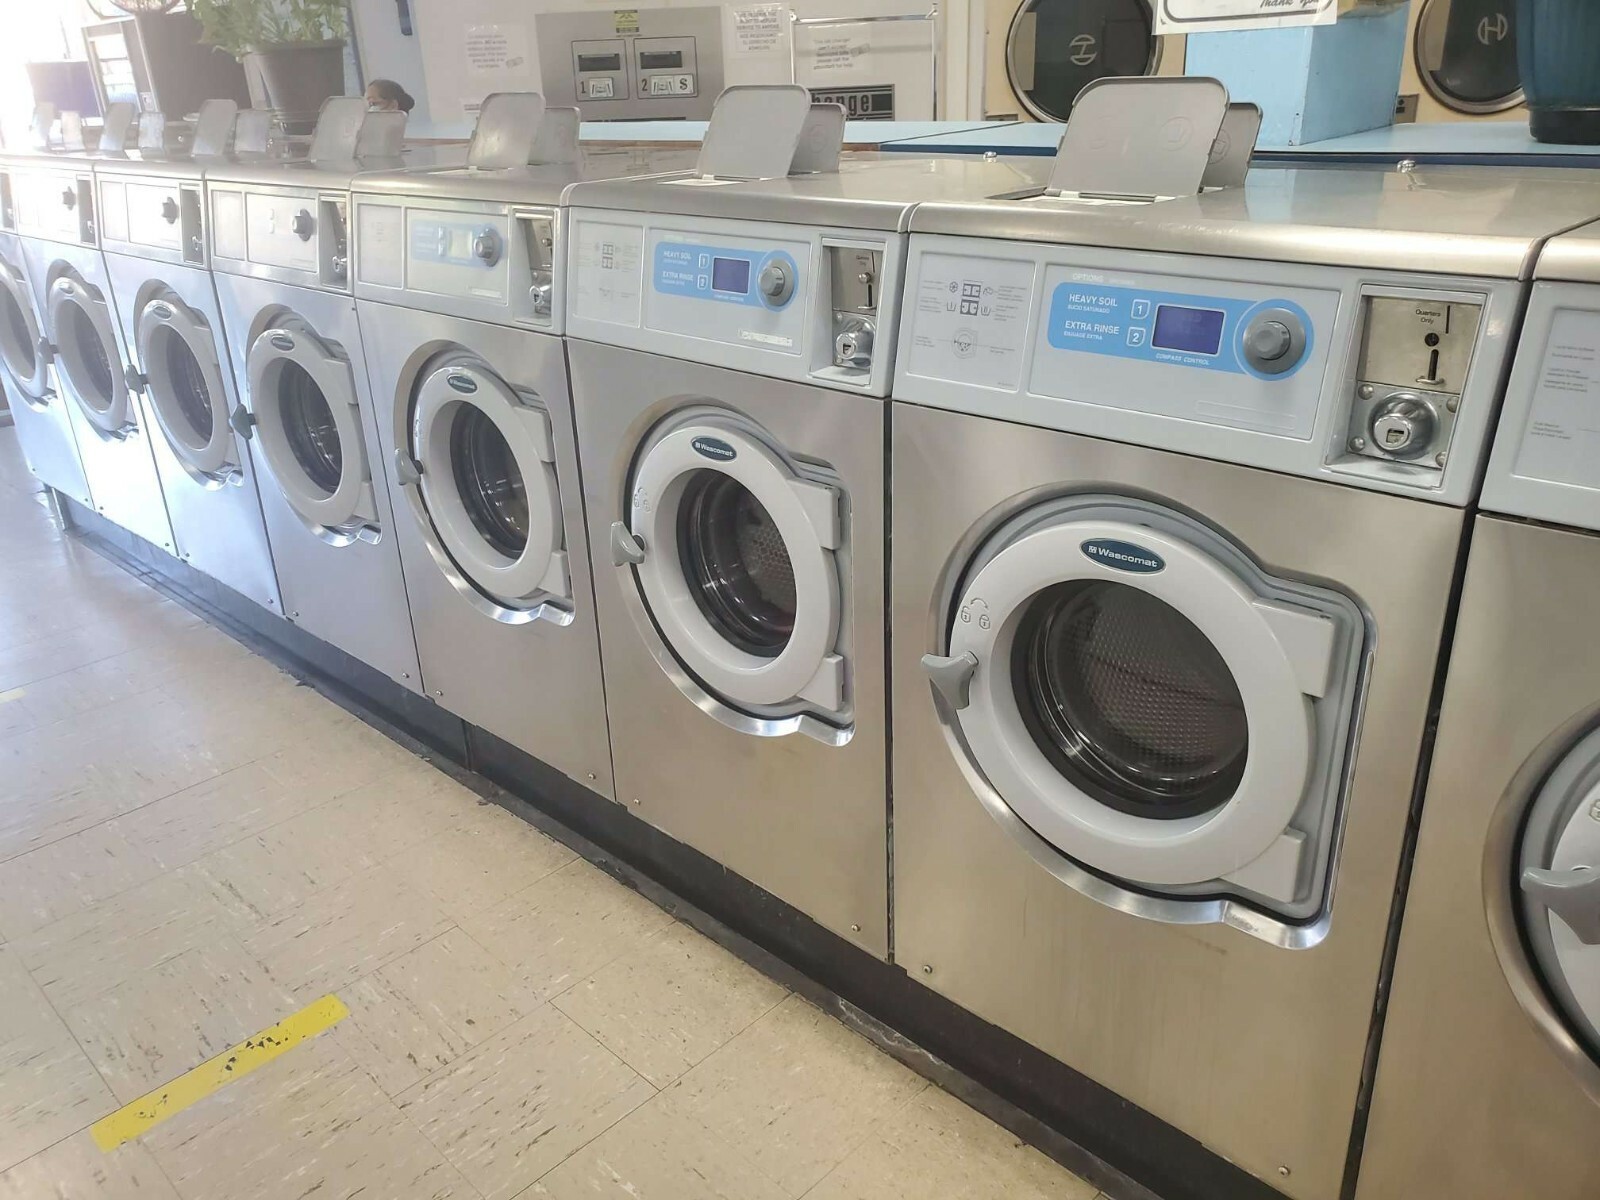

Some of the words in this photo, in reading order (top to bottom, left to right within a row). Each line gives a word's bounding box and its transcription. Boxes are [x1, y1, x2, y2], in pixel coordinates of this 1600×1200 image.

[641, 78, 648, 91] 2
[1069, 293, 1098, 305] HEAVY
[1098, 296, 1118, 307] SOIL
[1137, 305, 1143, 315] 1
[1415, 308, 1441, 317] Quarters
[1420, 316, 1434, 325] Only
[1065, 320, 1092, 331] EXTRA
[1093, 323, 1120, 335] RINSE
[1132, 332, 1140, 343] 2
[700, 443, 734, 457] Wascomat
[1098, 547, 1158, 568] Wascomat
